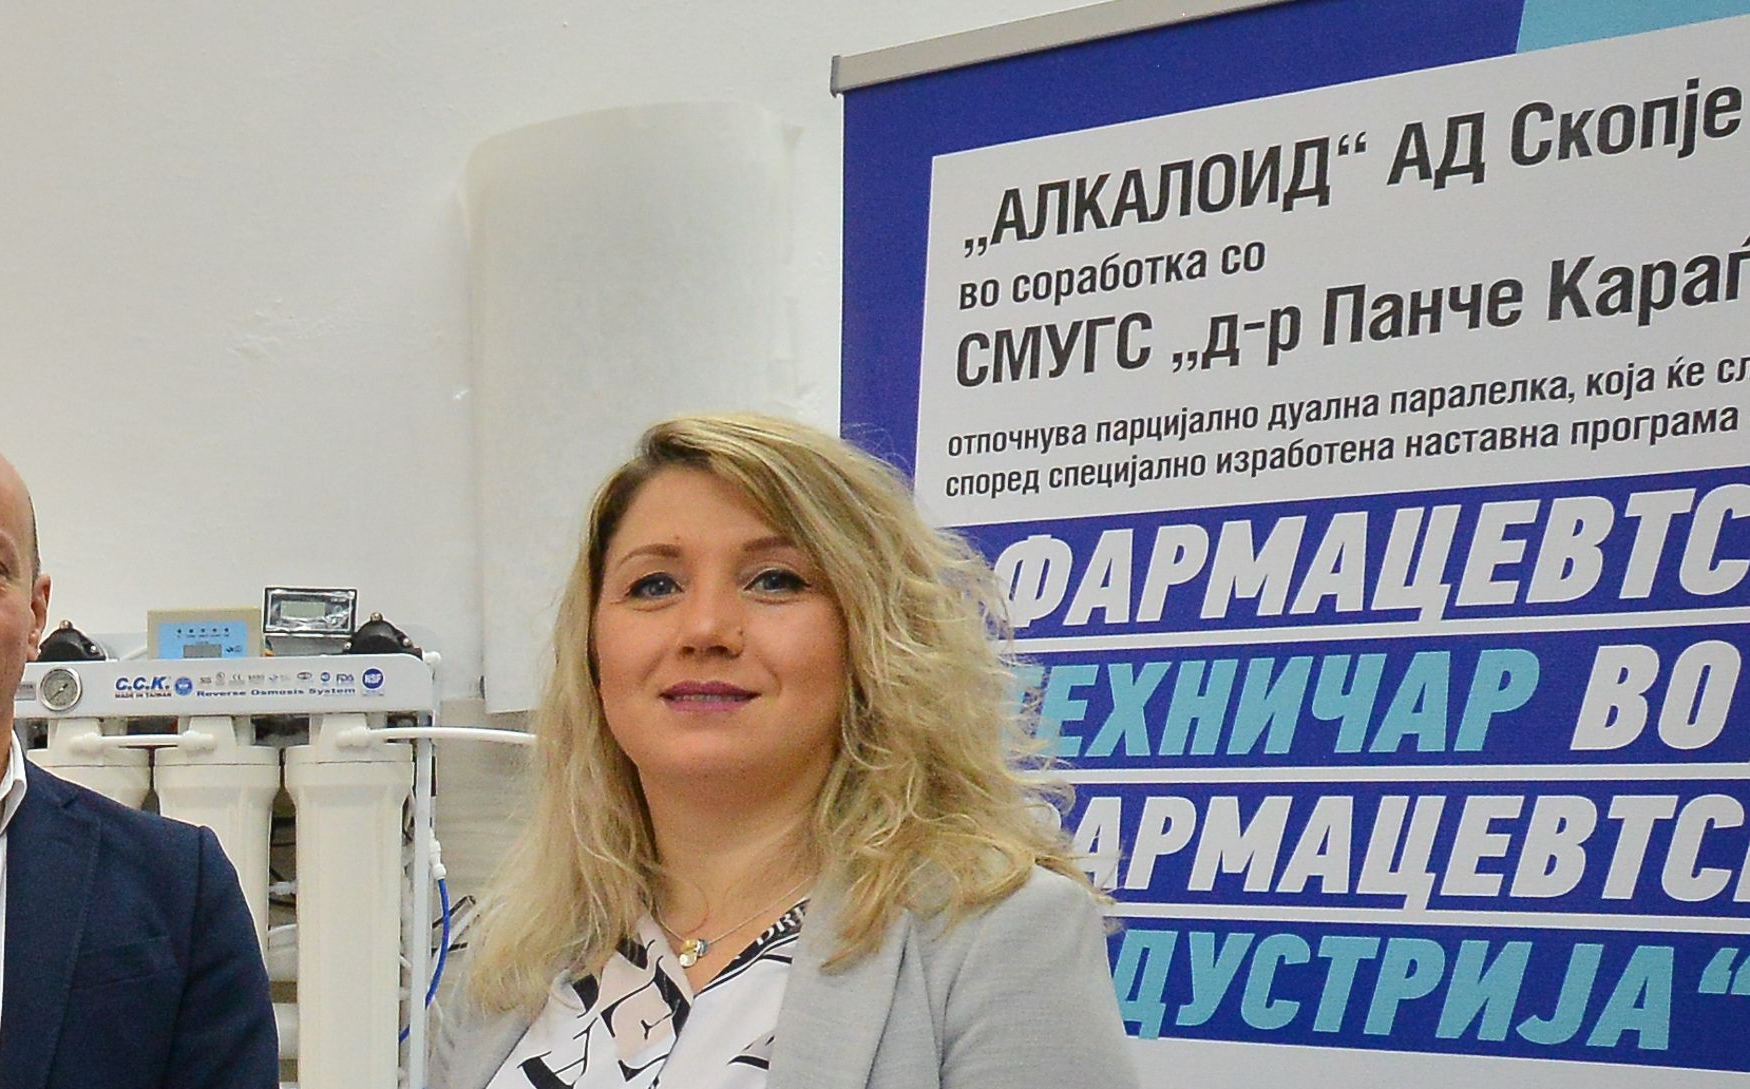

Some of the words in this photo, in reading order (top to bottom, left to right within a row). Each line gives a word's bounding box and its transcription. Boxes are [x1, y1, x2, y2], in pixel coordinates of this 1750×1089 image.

[964, 131, 1367, 259] „АЛКАЛОИД“
[1386, 111, 1486, 191] АД
[1510, 77, 1743, 167] Скопје
[959, 278, 1000, 311] во
[1012, 249, 1208, 307] соработка
[1221, 241, 1266, 275] со
[956, 311, 1153, 388] СМУГС
[1172, 305, 1302, 374] „д-р
[1322, 278, 1524, 347] Панче
[945, 469, 1040, 500] според
[1048, 454, 1206, 489] специјално
[1216, 437, 1395, 478] изработена
[1405, 423, 1559, 458] наставна
[1570, 406, 1739, 451] програма
[948, 423, 1087, 457] отпочнува
[1095, 406, 1259, 447] парцијално
[1267, 394, 1380, 432] дуална
[1390, 375, 1576, 418] паралелка,
[1585, 362, 1655, 401] која
[1666, 355, 1705, 390] ќе
[251, 688, 305, 696] Osmosis
[308, 687, 356, 696] System
[1570, 640, 1741, 750] ВО
[1025, 794, 1750, 911] АРМАЦЕВТС
